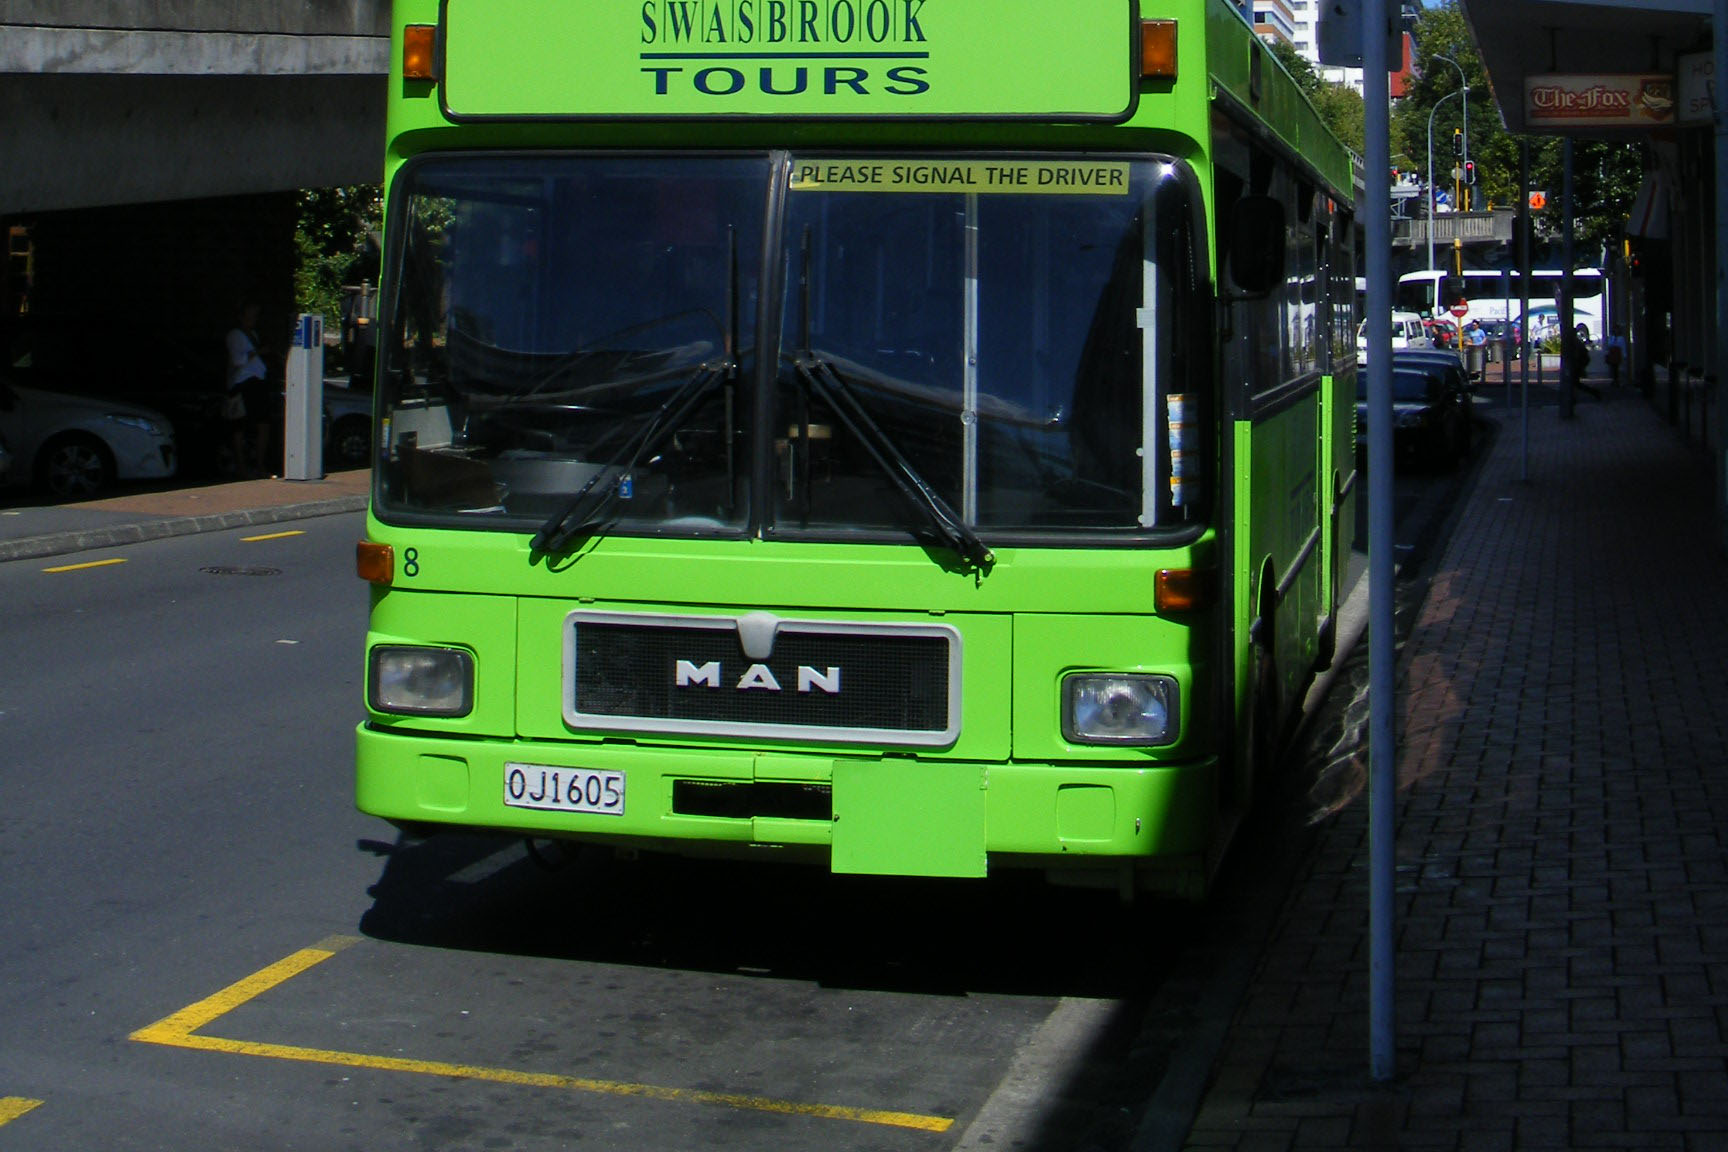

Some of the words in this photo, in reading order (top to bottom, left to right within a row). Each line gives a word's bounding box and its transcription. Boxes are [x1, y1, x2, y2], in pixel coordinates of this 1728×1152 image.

[640, 0, 928, 44] SWASBROOK
[640, 66, 931, 95] TOURS
[1534, 88, 1577, 108] The
[1581, 85, 1629, 110] Fox
[800, 165, 884, 184] PLEASE
[891, 165, 977, 185] SIGNAL
[985, 166, 1029, 185] THE
[1037, 167, 1124, 186] DRIVER
[403, 547, 419, 577] 8
[675, 659, 841, 694] MAN
[508, 768, 620, 808] OJ1605
